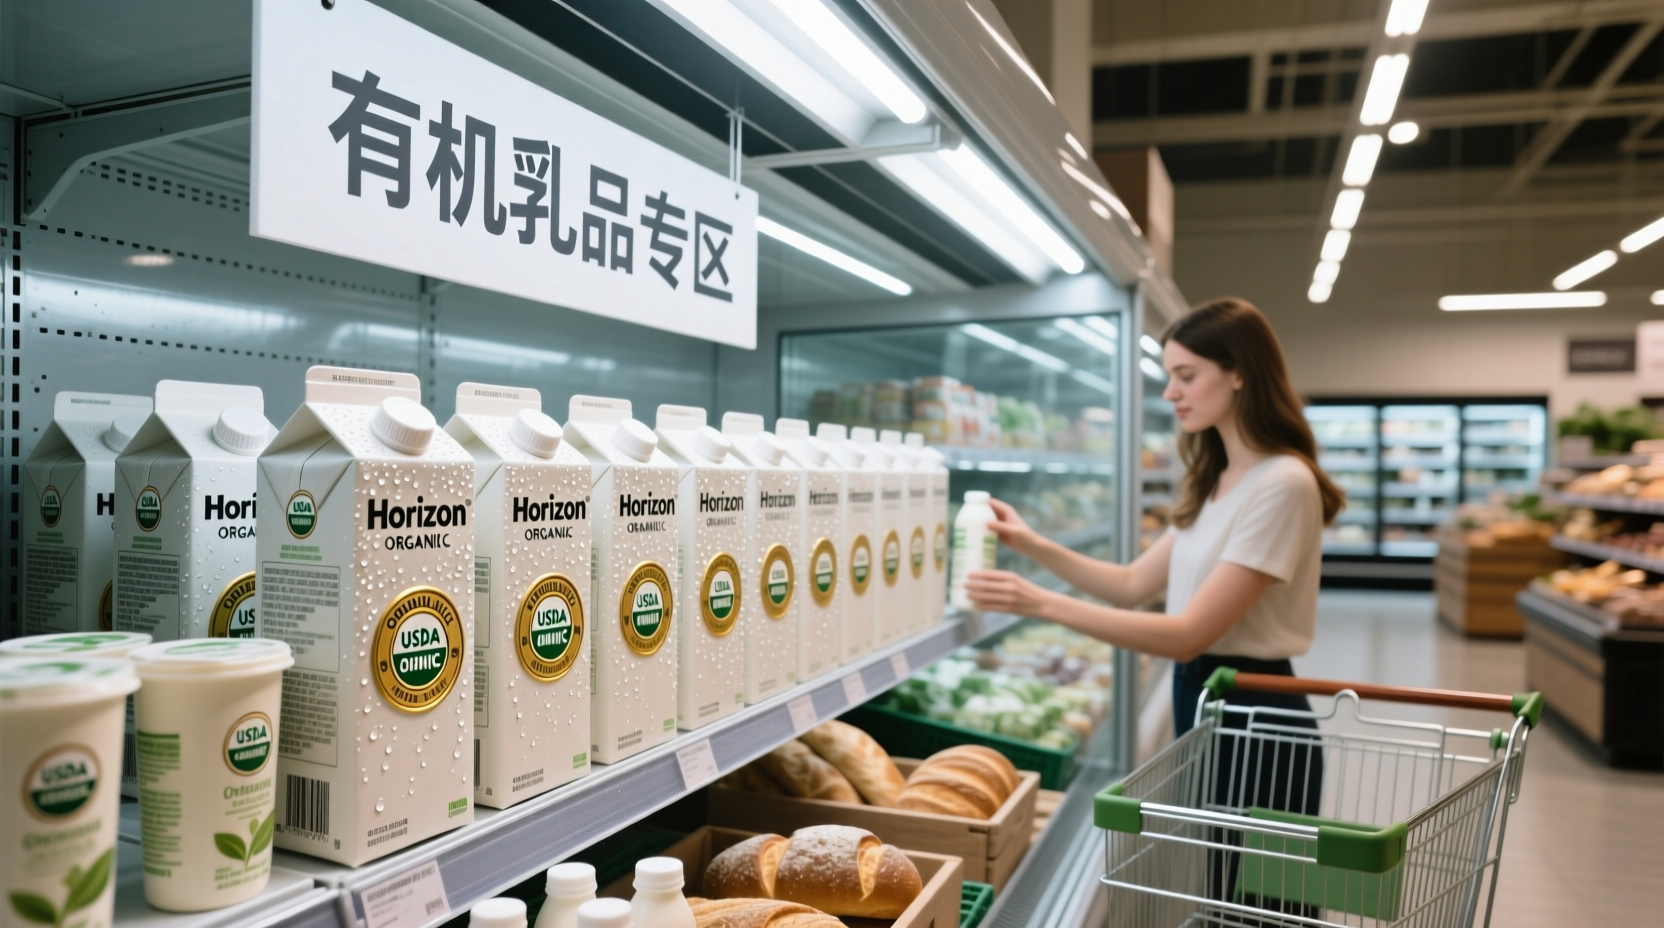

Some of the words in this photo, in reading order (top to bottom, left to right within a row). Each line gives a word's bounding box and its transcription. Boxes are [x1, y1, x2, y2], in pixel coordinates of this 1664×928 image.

[328, 70, 733, 303] 有机乳品专区
[204, 492, 256, 520] Hori
[368, 495, 466, 530] Horizon
[513, 493, 586, 522] Horizon
[619, 491, 675, 517] Horizon
[700, 490, 743, 512] Horizon
[218, 526, 256, 539] ORGA
[239, 608, 255, 625] US
[401, 628, 440, 649] USDA
[236, 725, 267, 744] USDA
